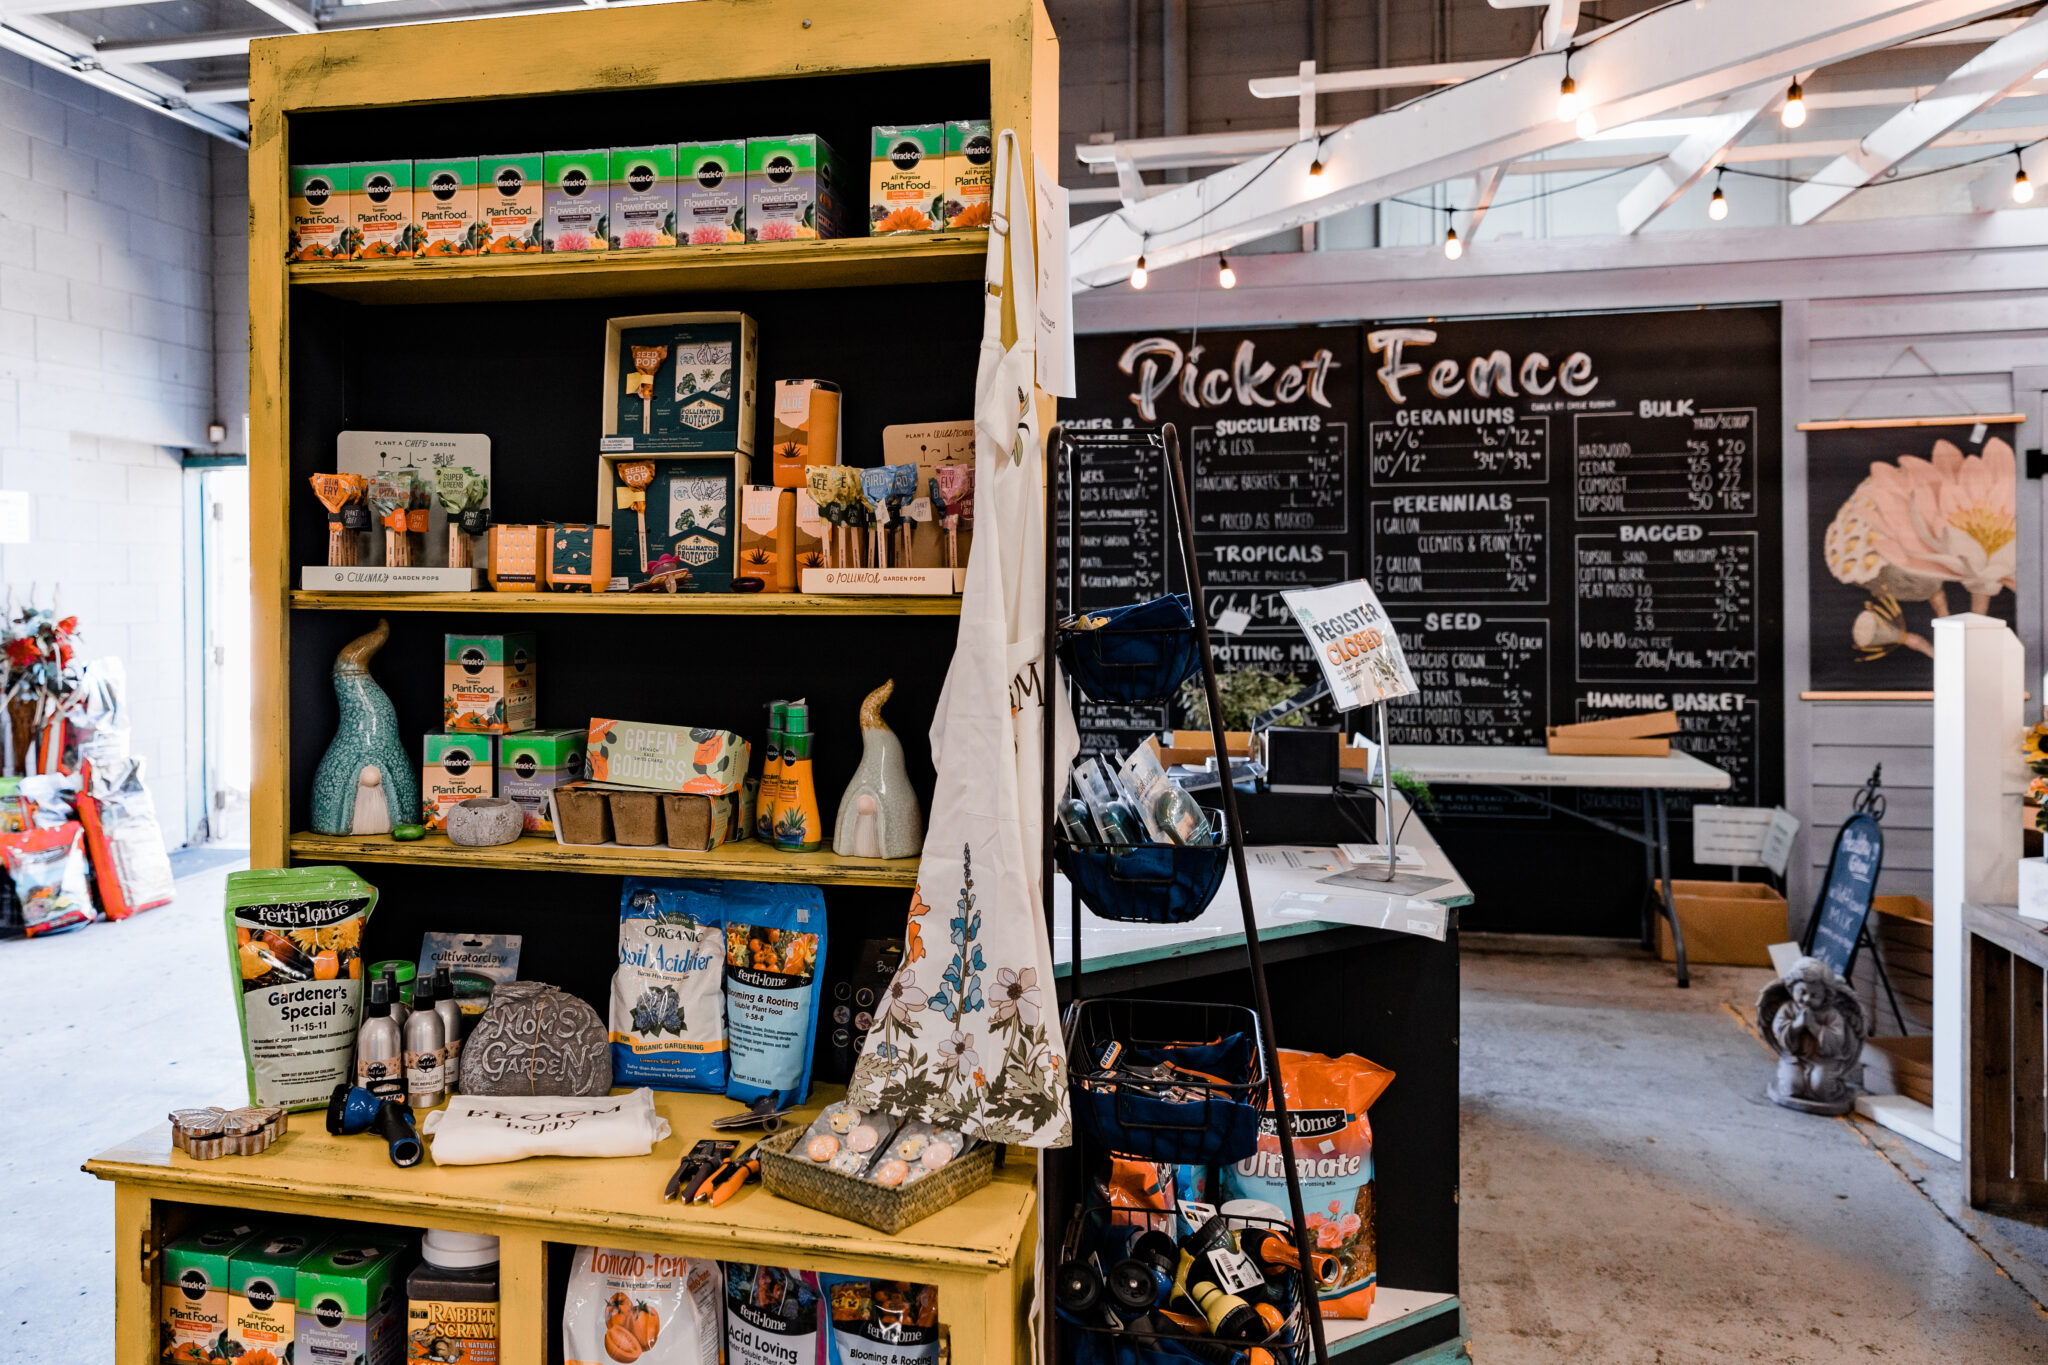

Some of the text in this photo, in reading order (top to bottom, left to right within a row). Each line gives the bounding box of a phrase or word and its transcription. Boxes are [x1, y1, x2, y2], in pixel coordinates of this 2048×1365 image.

[891, 152, 922, 160] Miracle-Gro
[697, 171, 725, 180] Miracle-Gro
[955, 177, 979, 185] Plant
[881, 181, 930, 190] Plant Food
[752, 192, 807, 203] Flower Food
[486, 206, 531, 216] Plant Food
[615, 200, 668, 212] Flower Food
[295, 216, 339, 224] Plant Food
[358, 212, 401, 222] Plant Food
[422, 211, 467, 220] Plant Food
[636, 358, 658, 367] POP
[1368, 328, 1599, 404] Fence
[1118, 338, 1341, 420] Picket
[780, 398, 804, 409] ALOE
[1639, 399, 1694, 418] BULK
[680, 414, 721, 427] PROTECTOR
[1396, 408, 1515, 426] GERANIUMS
[1216, 415, 1321, 437] SUCCULENTS
[1231, 439, 1255, 455] LESS
[1579, 443, 1631, 458] HARDWOOD
[625, 466, 646, 475] SEED
[1579, 460, 1616, 475] CEDAR
[443, 473, 463, 481] SUPER
[625, 473, 648, 483] POP
[813, 477, 827, 490] BEE
[866, 474, 885, 485] BIRD
[1196, 474, 1279, 491] HANGING BASKETS
[324, 486, 338, 496] FRY
[1579, 476, 1627, 494] COMPOST
[1393, 493, 1513, 513] PERENNIALS
[1579, 496, 1625, 512] TOPSOIL
[1220, 512, 1315, 529] PRICED AS MARKED
[1383, 517, 1419, 534] GALLON
[1619, 525, 1703, 542] BAGGED
[1418, 535, 1511, 553] CLEMATIS & PEONY
[677, 552, 718, 563] PROTECTOR
[1214, 545, 1323, 563] TROPICALS
[1622, 551, 1648, 563] SAND
[1386, 556, 1422, 573] GALLON
[347, 572, 389, 583] CULINARY
[837, 573, 880, 584] POLLINATOR
[1208, 569, 1306, 582] MULTIPLE PRICES
[1579, 567, 1645, 581] COTTON BURR
[1387, 576, 1423, 592] GALLON
[1579, 583, 1634, 598] PEAT MOSS
[1312, 602, 1381, 644] REGISTER
[1425, 613, 1482, 631] SEED
[1327, 627, 1382, 666] CLOSED
[1520, 636, 1543, 649] EACH
[1210, 645, 1284, 661] POTTING
[1452, 654, 1486, 669] CROWN
[1424, 672, 1449, 686] SETS
[452, 684, 494, 693] Plant Food
[1423, 690, 1462, 706] PLANTS
[1587, 691, 1746, 711] HANGING BASKET
[1391, 709, 1494, 725] SWEET POTATO SLIPS
[625, 728, 677, 755] GREEN
[1390, 729, 1465, 743] POTATO SETS
[612, 753, 686, 783] GODDESS
[433, 786, 481, 794] Plant Food
[503, 786, 548, 795] Flower Food
[645, 926, 704, 942] ORGANIC
[431, 950, 508, 965] cultivatorclaw
[649, 944, 713, 973] Acidifier
[268, 986, 347, 1006] Gardener's
[758, 995, 799, 1010] & Rooting
[281, 1002, 336, 1022] Special
[745, 1013, 764, 1021] 9-58-8
[290, 1021, 327, 1032] 11-15-11
[1102, 1043, 1117, 1066] DRAMM
[482, 1042, 591, 1095] GARDEN
[1238, 1150, 1360, 1178] Ultmate
[180, 1280, 209, 1290] Miracle-Gro
[170, 1307, 218, 1323] Plant Food
[316, 1308, 344, 1318] Miracle-Gro
[429, 1303, 495, 1323] RABBIT
[237, 1319, 284, 1333] Plant Food
[435, 1323, 495, 1340] SCRAM
[729, 1325, 751, 1345] Acid
[755, 1336, 798, 1364] Loving
[850, 1349, 888, 1364] Blooming
[891, 1355, 897, 1363] &
